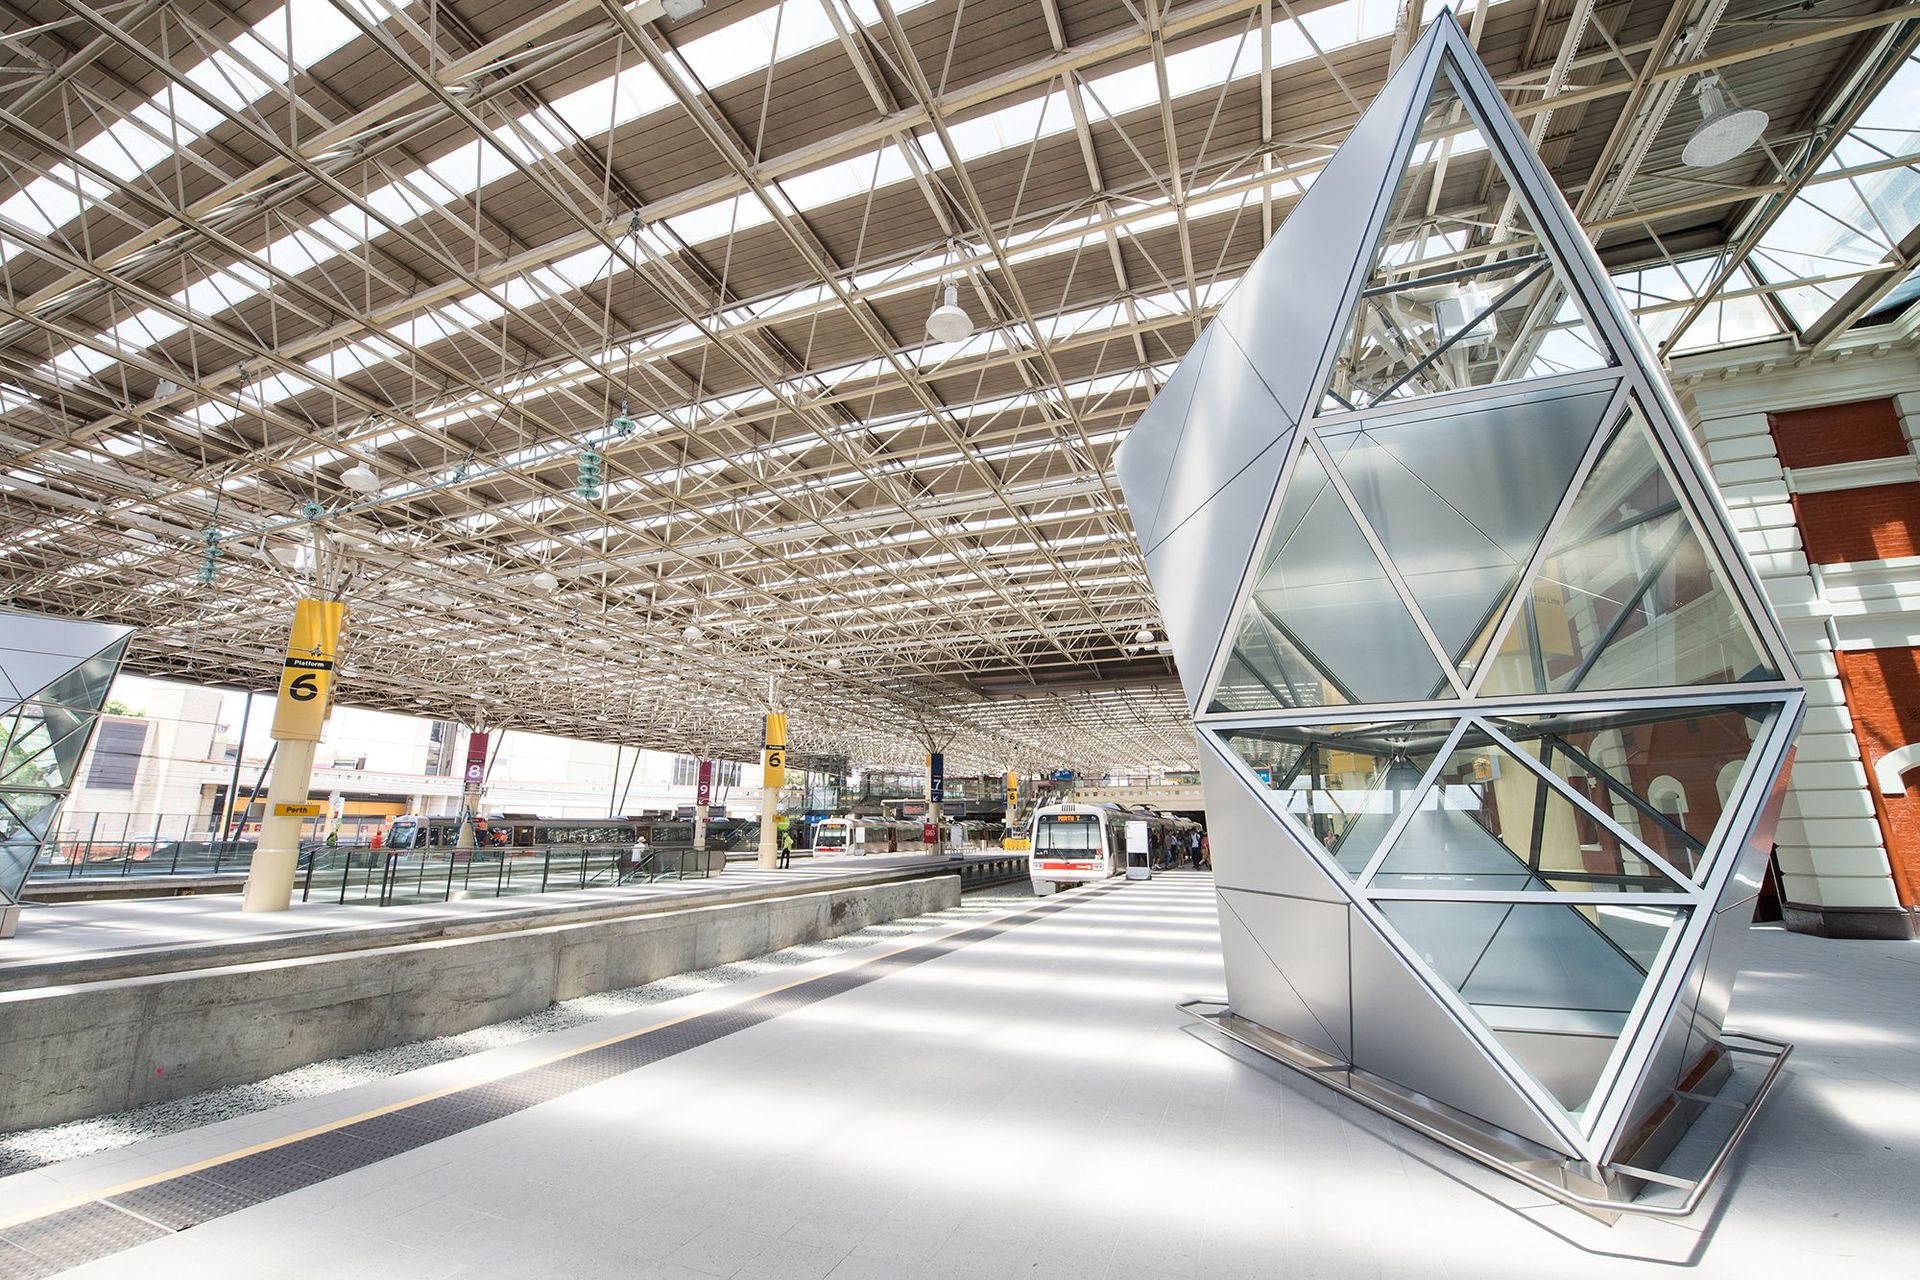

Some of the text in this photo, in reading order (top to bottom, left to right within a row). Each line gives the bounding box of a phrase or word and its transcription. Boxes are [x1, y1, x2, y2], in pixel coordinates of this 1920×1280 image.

[294, 660, 325, 668] Platform
[289, 674, 318, 701] 6
[768, 753, 781, 767] 6
[468, 765, 481, 778] 8
[700, 785, 708, 795] 9
[933, 780, 941, 790] 7
